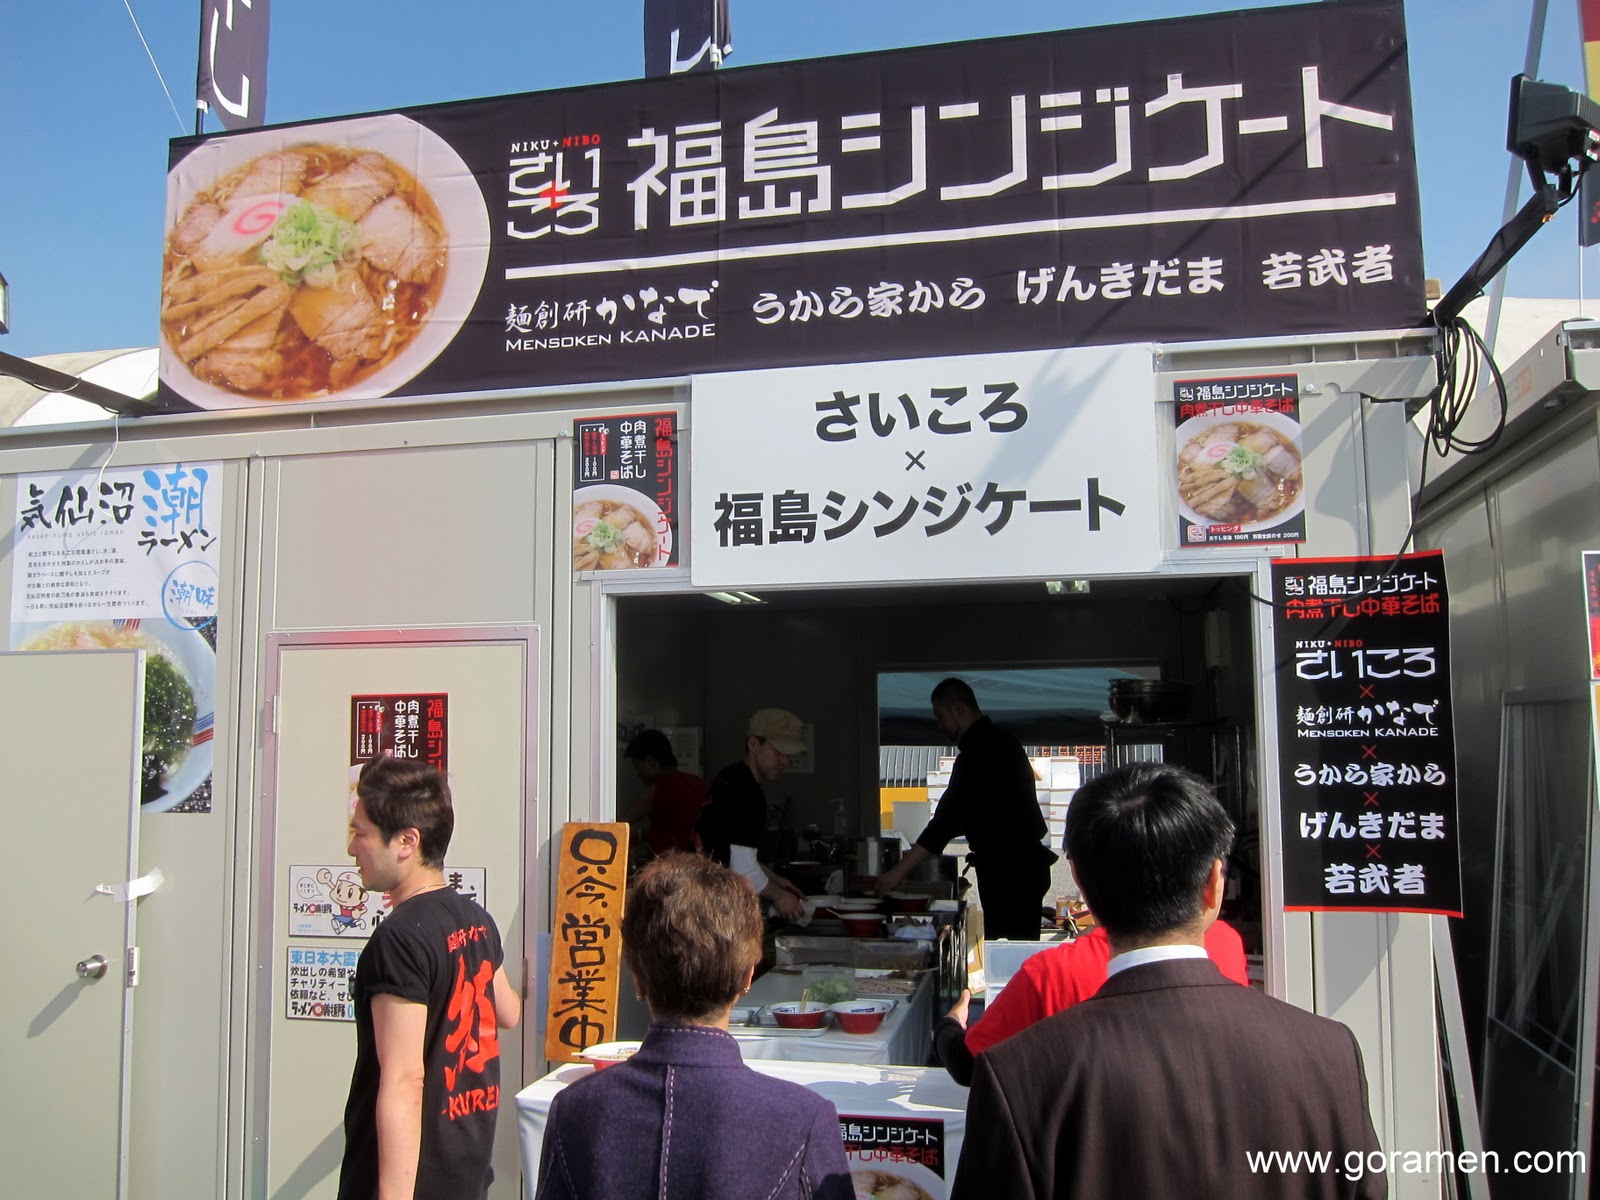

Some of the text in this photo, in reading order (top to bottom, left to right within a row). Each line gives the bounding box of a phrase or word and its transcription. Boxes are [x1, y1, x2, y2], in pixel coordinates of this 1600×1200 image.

[626, 66, 1394, 230] 福島シンジケート
[752, 244, 1394, 325] うから家から げんきだま 若武者
[505, 323, 716, 352] MENSOKEN KANADE
[815, 381, 1028, 442] さいころ
[1196, 382, 1293, 400] 福島シンジケート
[620, 420, 634, 479] 中華そば
[634, 420, 647, 479] 肉煮干し
[20, 482, 135, 532] 気仙沼
[142, 462, 209, 535] 潮
[655, 417, 673, 560] 福島シンジケート
[713, 477, 1126, 548] 福島シンジケート
[137, 529, 217, 556] ラーメン
[1308, 572, 1437, 596] 福島シンジケート
[394, 700, 407, 758] 中華そば
[407, 700, 420, 758] 肉煮干し
[1298, 727, 1438, 738] MENSOKEN KANADE
[1294, 762, 1446, 787] うから家から
[1300, 811, 1446, 840] げんきだま
[1324, 863, 1426, 895] 若武者
[290, 950, 360, 966] 東日本大震
[553, 829, 618, 1058] 只今営業中
[291, 978, 346, 990] チャリティー
